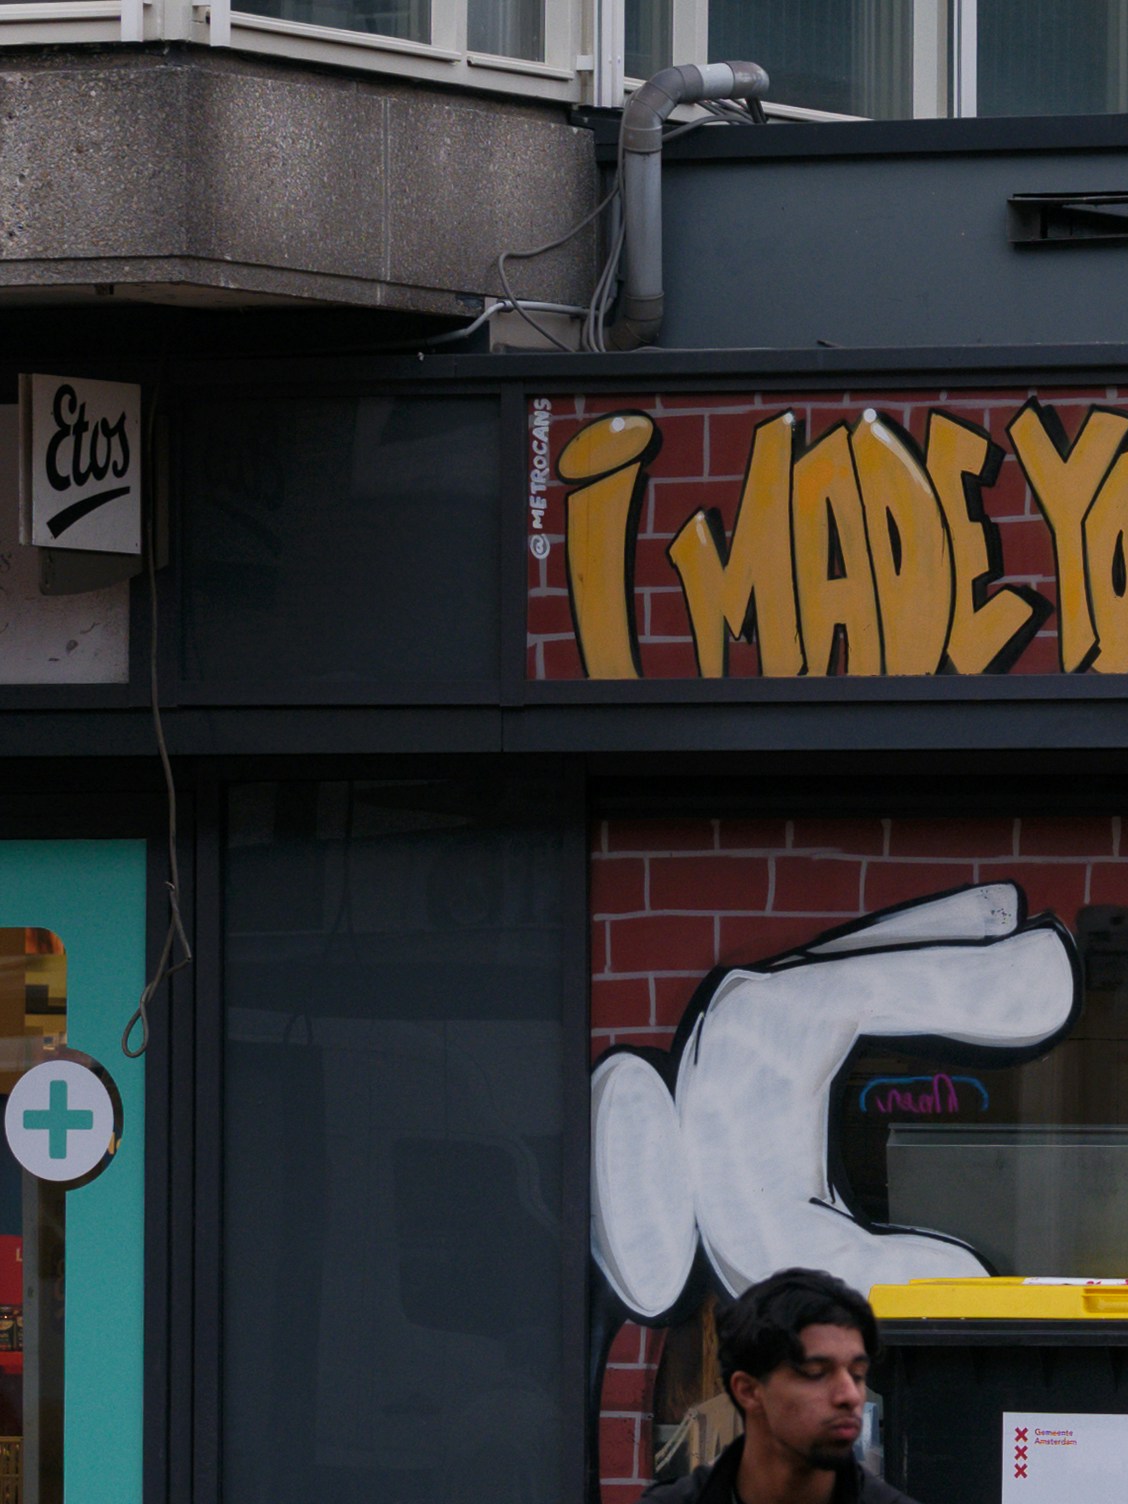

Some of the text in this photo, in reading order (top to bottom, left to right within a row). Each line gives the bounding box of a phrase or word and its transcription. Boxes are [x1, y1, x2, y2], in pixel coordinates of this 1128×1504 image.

[46, 384, 130, 491] Etos
[666, 406, 1054, 678] MADE
[1034, 1437, 1077, 1446] Amsterdam
